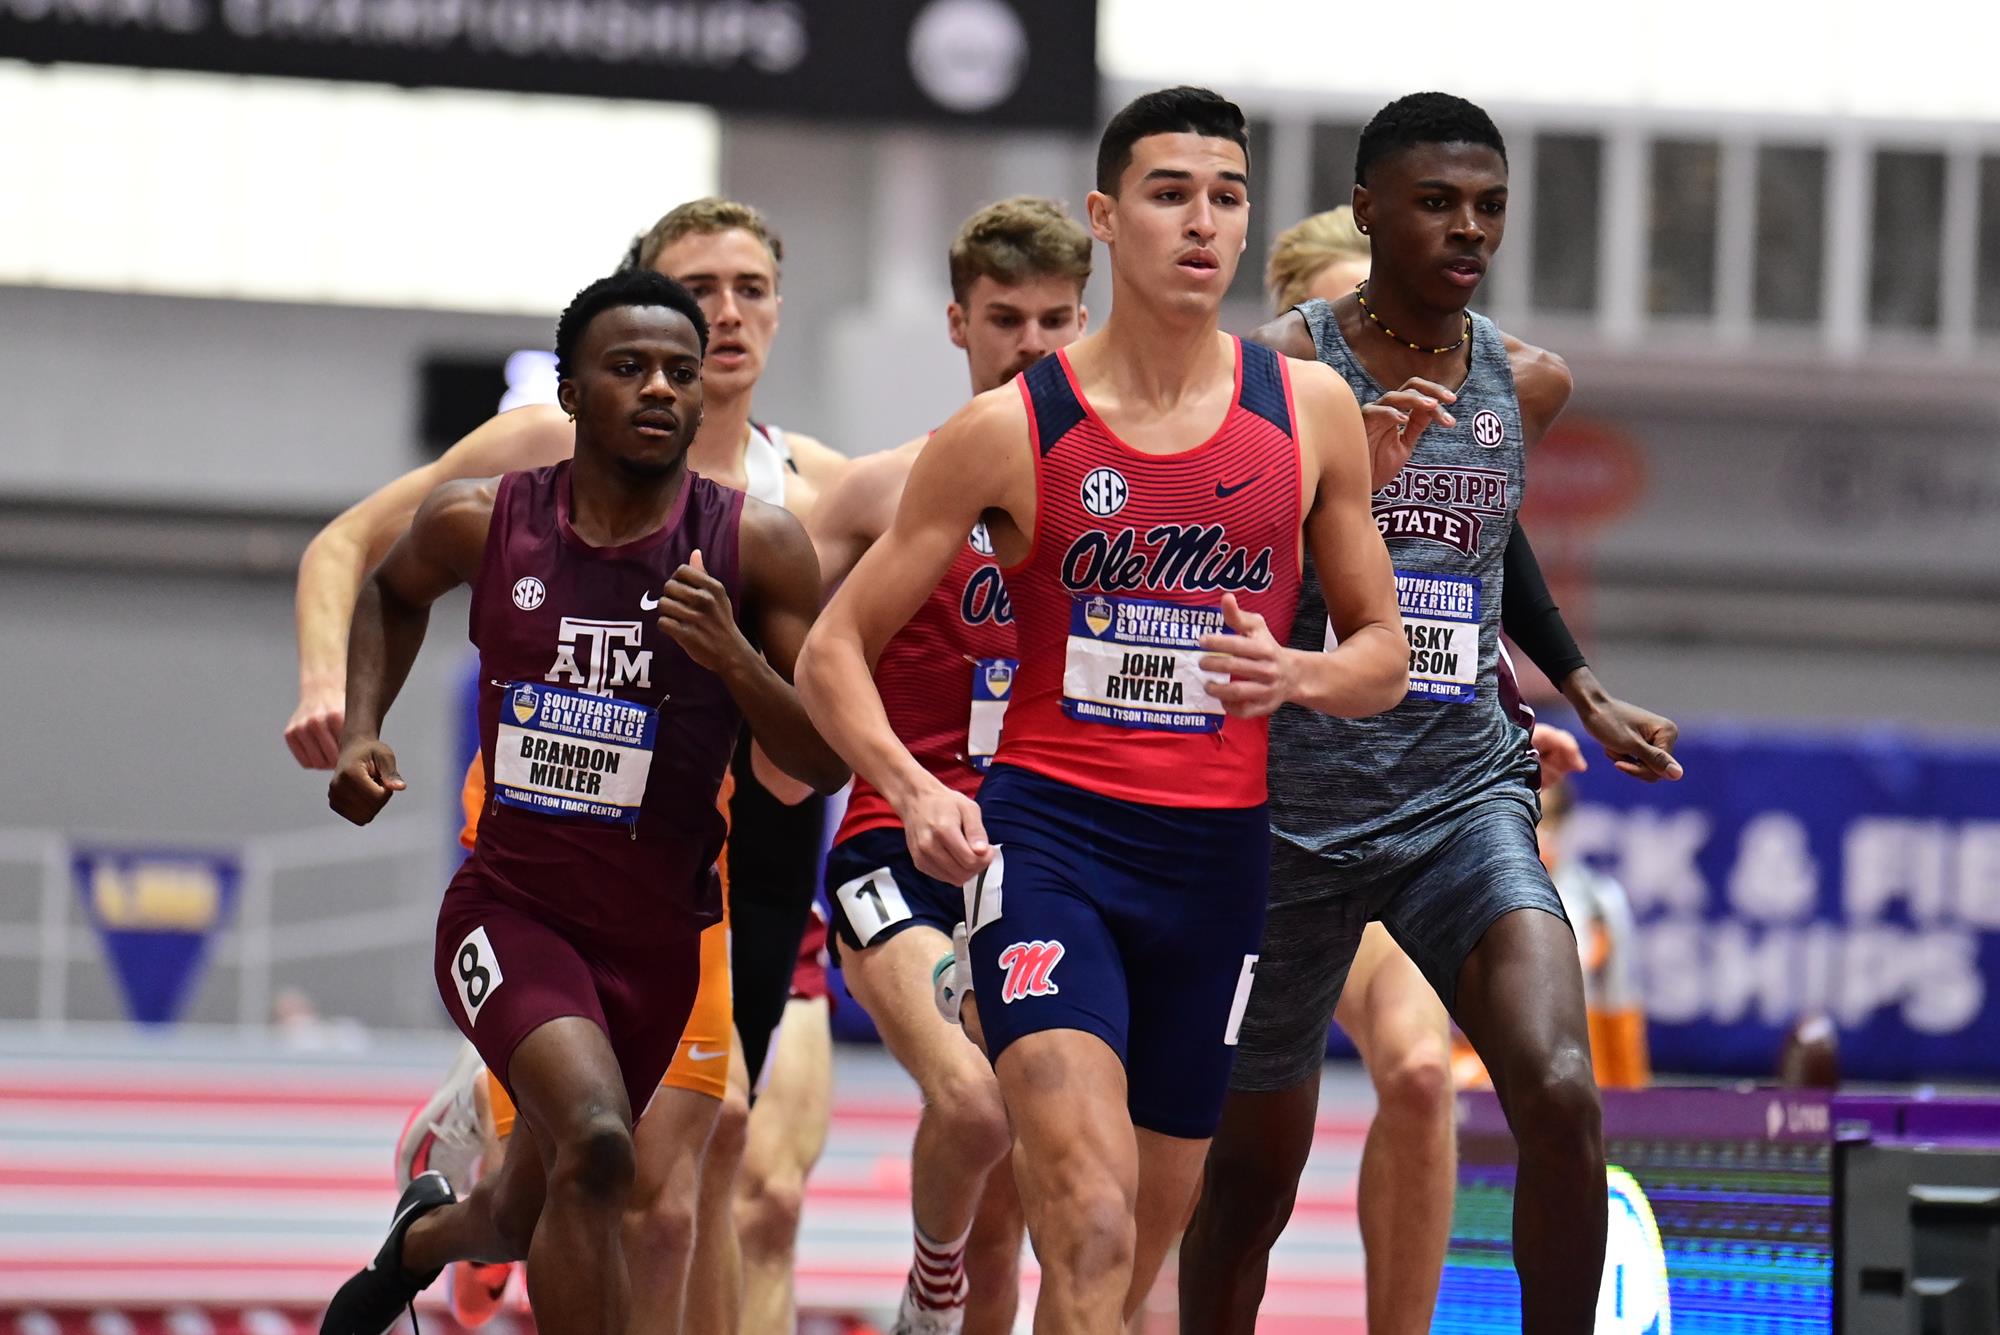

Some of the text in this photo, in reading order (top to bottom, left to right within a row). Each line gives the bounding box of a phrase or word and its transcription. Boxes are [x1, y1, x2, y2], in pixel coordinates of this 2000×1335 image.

[1476, 414, 1500, 443] SEC
[1084, 470, 1124, 514] SEC
[1061, 524, 1273, 592] Ole Miss
[514, 579, 543, 608] SEC
[1116, 603, 1224, 627] SOUTHEASTERN
[1120, 652, 1176, 678] JOHN
[1106, 675, 1184, 705] RIVERA
[1430, 683, 1460, 696] CENTER
[540, 706, 644, 738] CONFERENCE
[543, 692, 647, 724] SOUTHEASTERN
[1077, 702, 1206, 727] RANDAL TYSON TRACK CENTER
[520, 735, 620, 774] BRANDON
[529, 762, 602, 795] MILLER
[504, 788, 622, 818] RANDAL TYSON TRACK CENTER
[855, 879, 891, 924] 1
[458, 943, 490, 1008] 8
